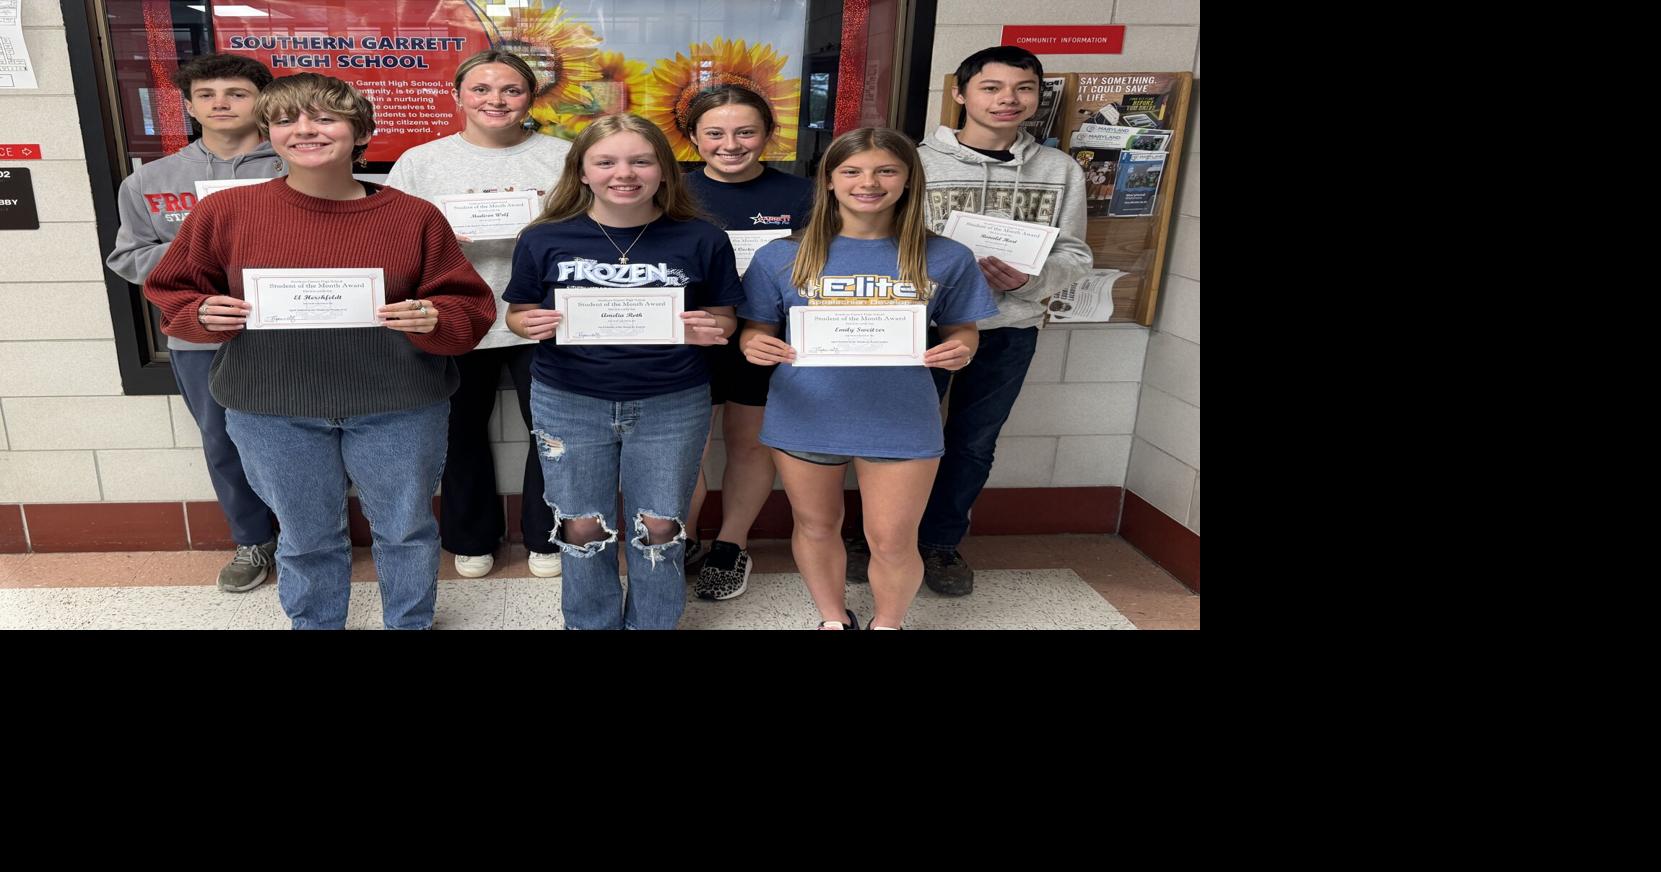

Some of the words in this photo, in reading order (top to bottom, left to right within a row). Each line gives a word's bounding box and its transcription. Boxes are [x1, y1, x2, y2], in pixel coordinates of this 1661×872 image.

[230, 36, 355, 50] SOUTHERN
[361, 36, 466, 50] GARRETT
[1016, 36, 1057, 44] COMMUNITY
[1060, 36, 1108, 44] INFORMATION
[271, 54, 331, 69] HIGH
[337, 54, 429, 69] SCHOOL
[388, 80, 409, 88] High
[1080, 77, 1098, 85] SAY
[1101, 76, 1157, 85] SOMETHING.
[417, 88, 449, 96] provide
[1078, 85, 1088, 93] IT
[1090, 85, 1122, 93] COULD
[1125, 84, 1149, 93] SAVE
[394, 95, 434, 103] nurturing
[1076, 94, 1083, 102] A
[1086, 94, 1108, 102] LIFE.
[931, 190, 1054, 221] REATREE
[557, 260, 667, 288] FROZEN
[822, 275, 919, 298] Elite
